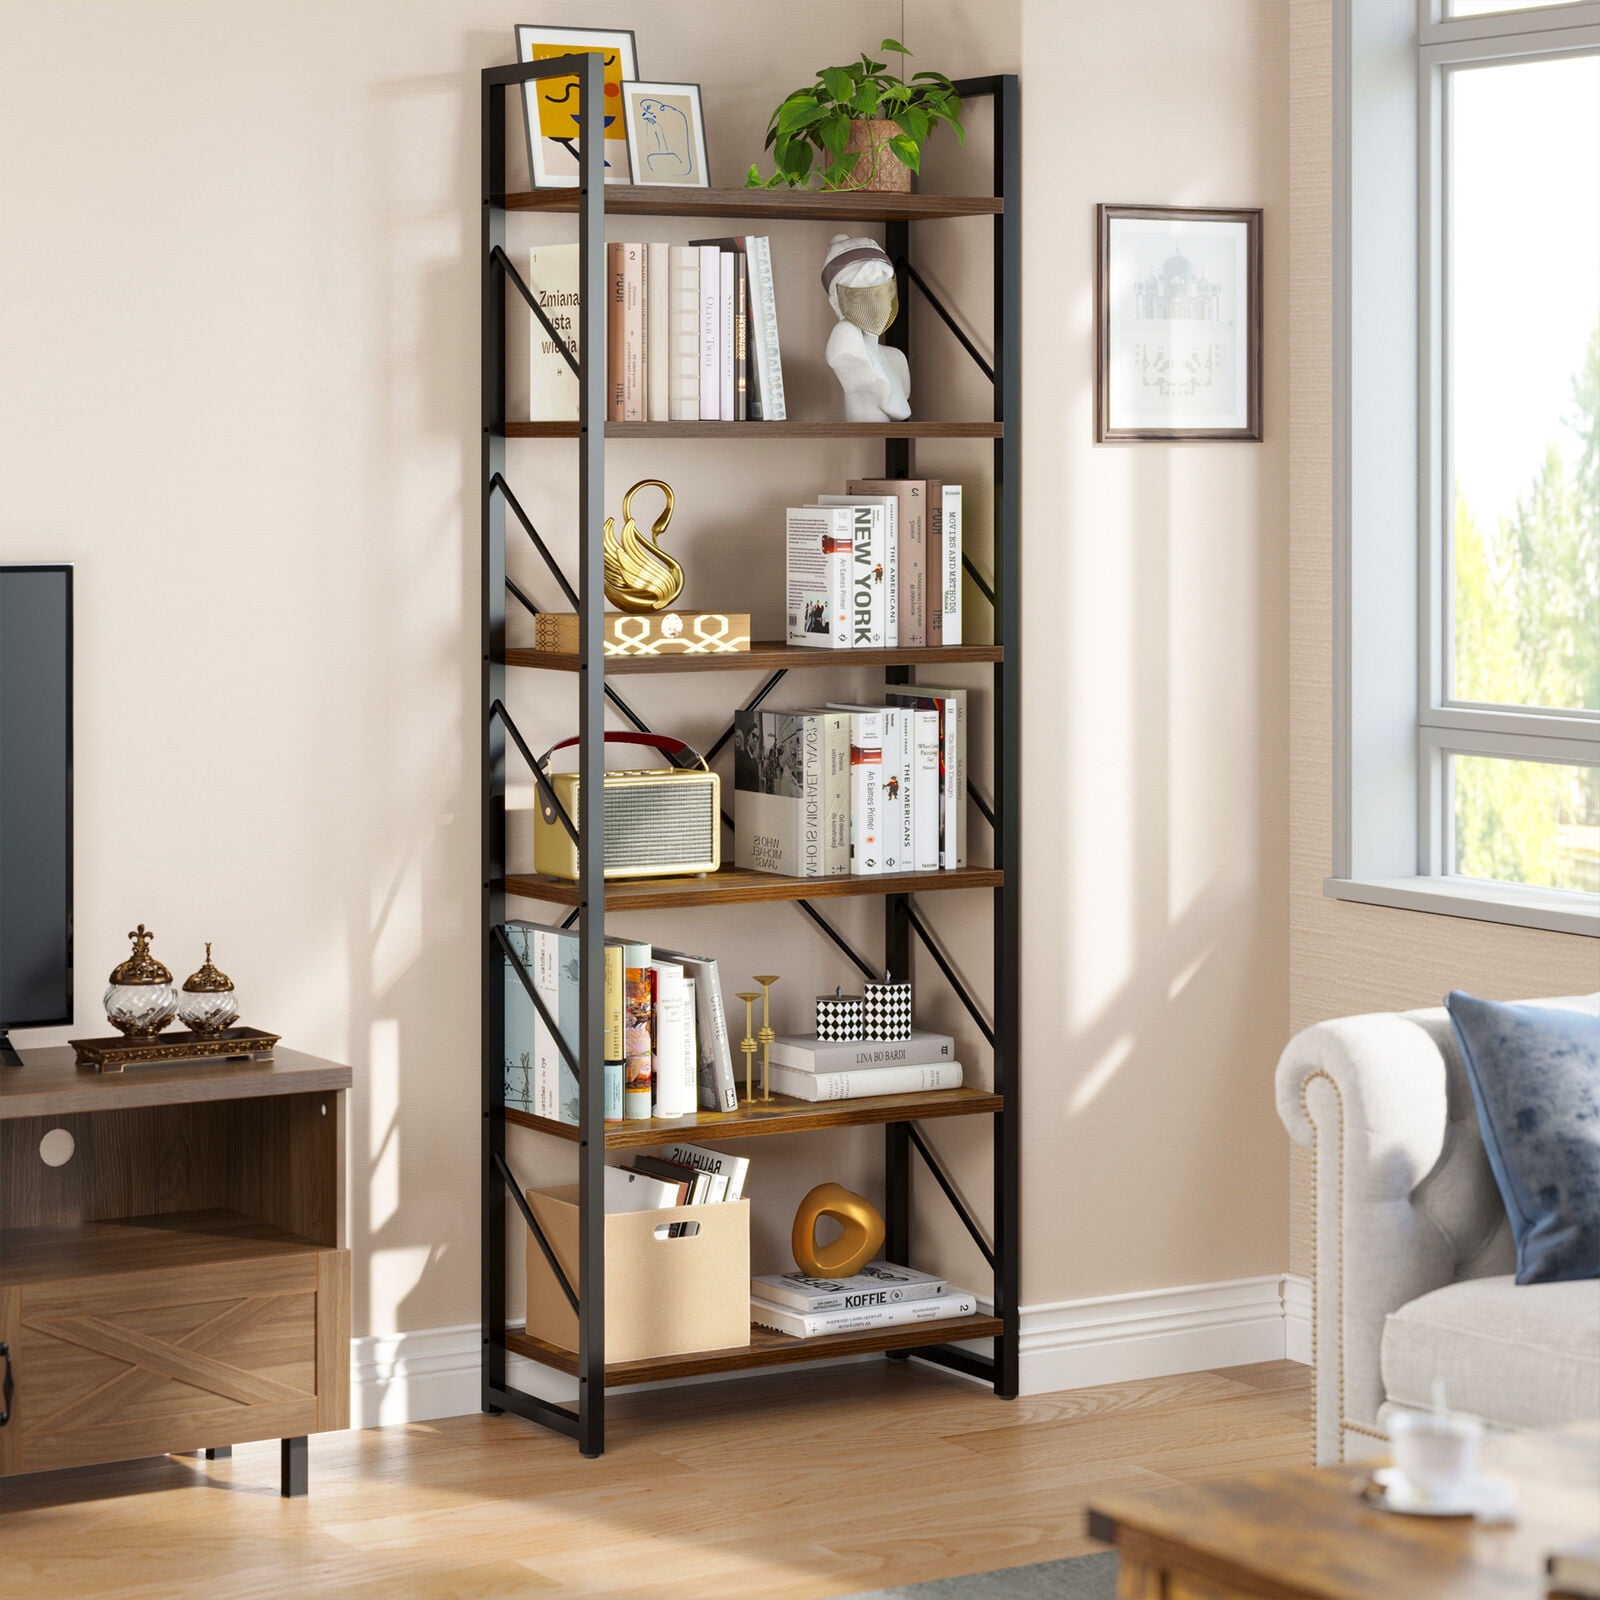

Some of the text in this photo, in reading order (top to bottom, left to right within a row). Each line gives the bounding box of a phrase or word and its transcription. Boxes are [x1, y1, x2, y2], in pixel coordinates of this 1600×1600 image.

[629, 250, 636, 261] 2
[540, 290, 580, 307] Zmiana
[541, 336, 577, 354] wieia
[949, 511, 957, 614] MOVIES AND METHODS
[839, 559, 847, 610] An Eames Primer
[854, 508, 871, 645] NEW YORK
[867, 771, 875, 831] An Eames Primer
[856, 1049, 906, 1064] LINA BO BARDI
[844, 1291, 887, 1308] KOFFIE
[959, 1304, 969, 1312] 2
